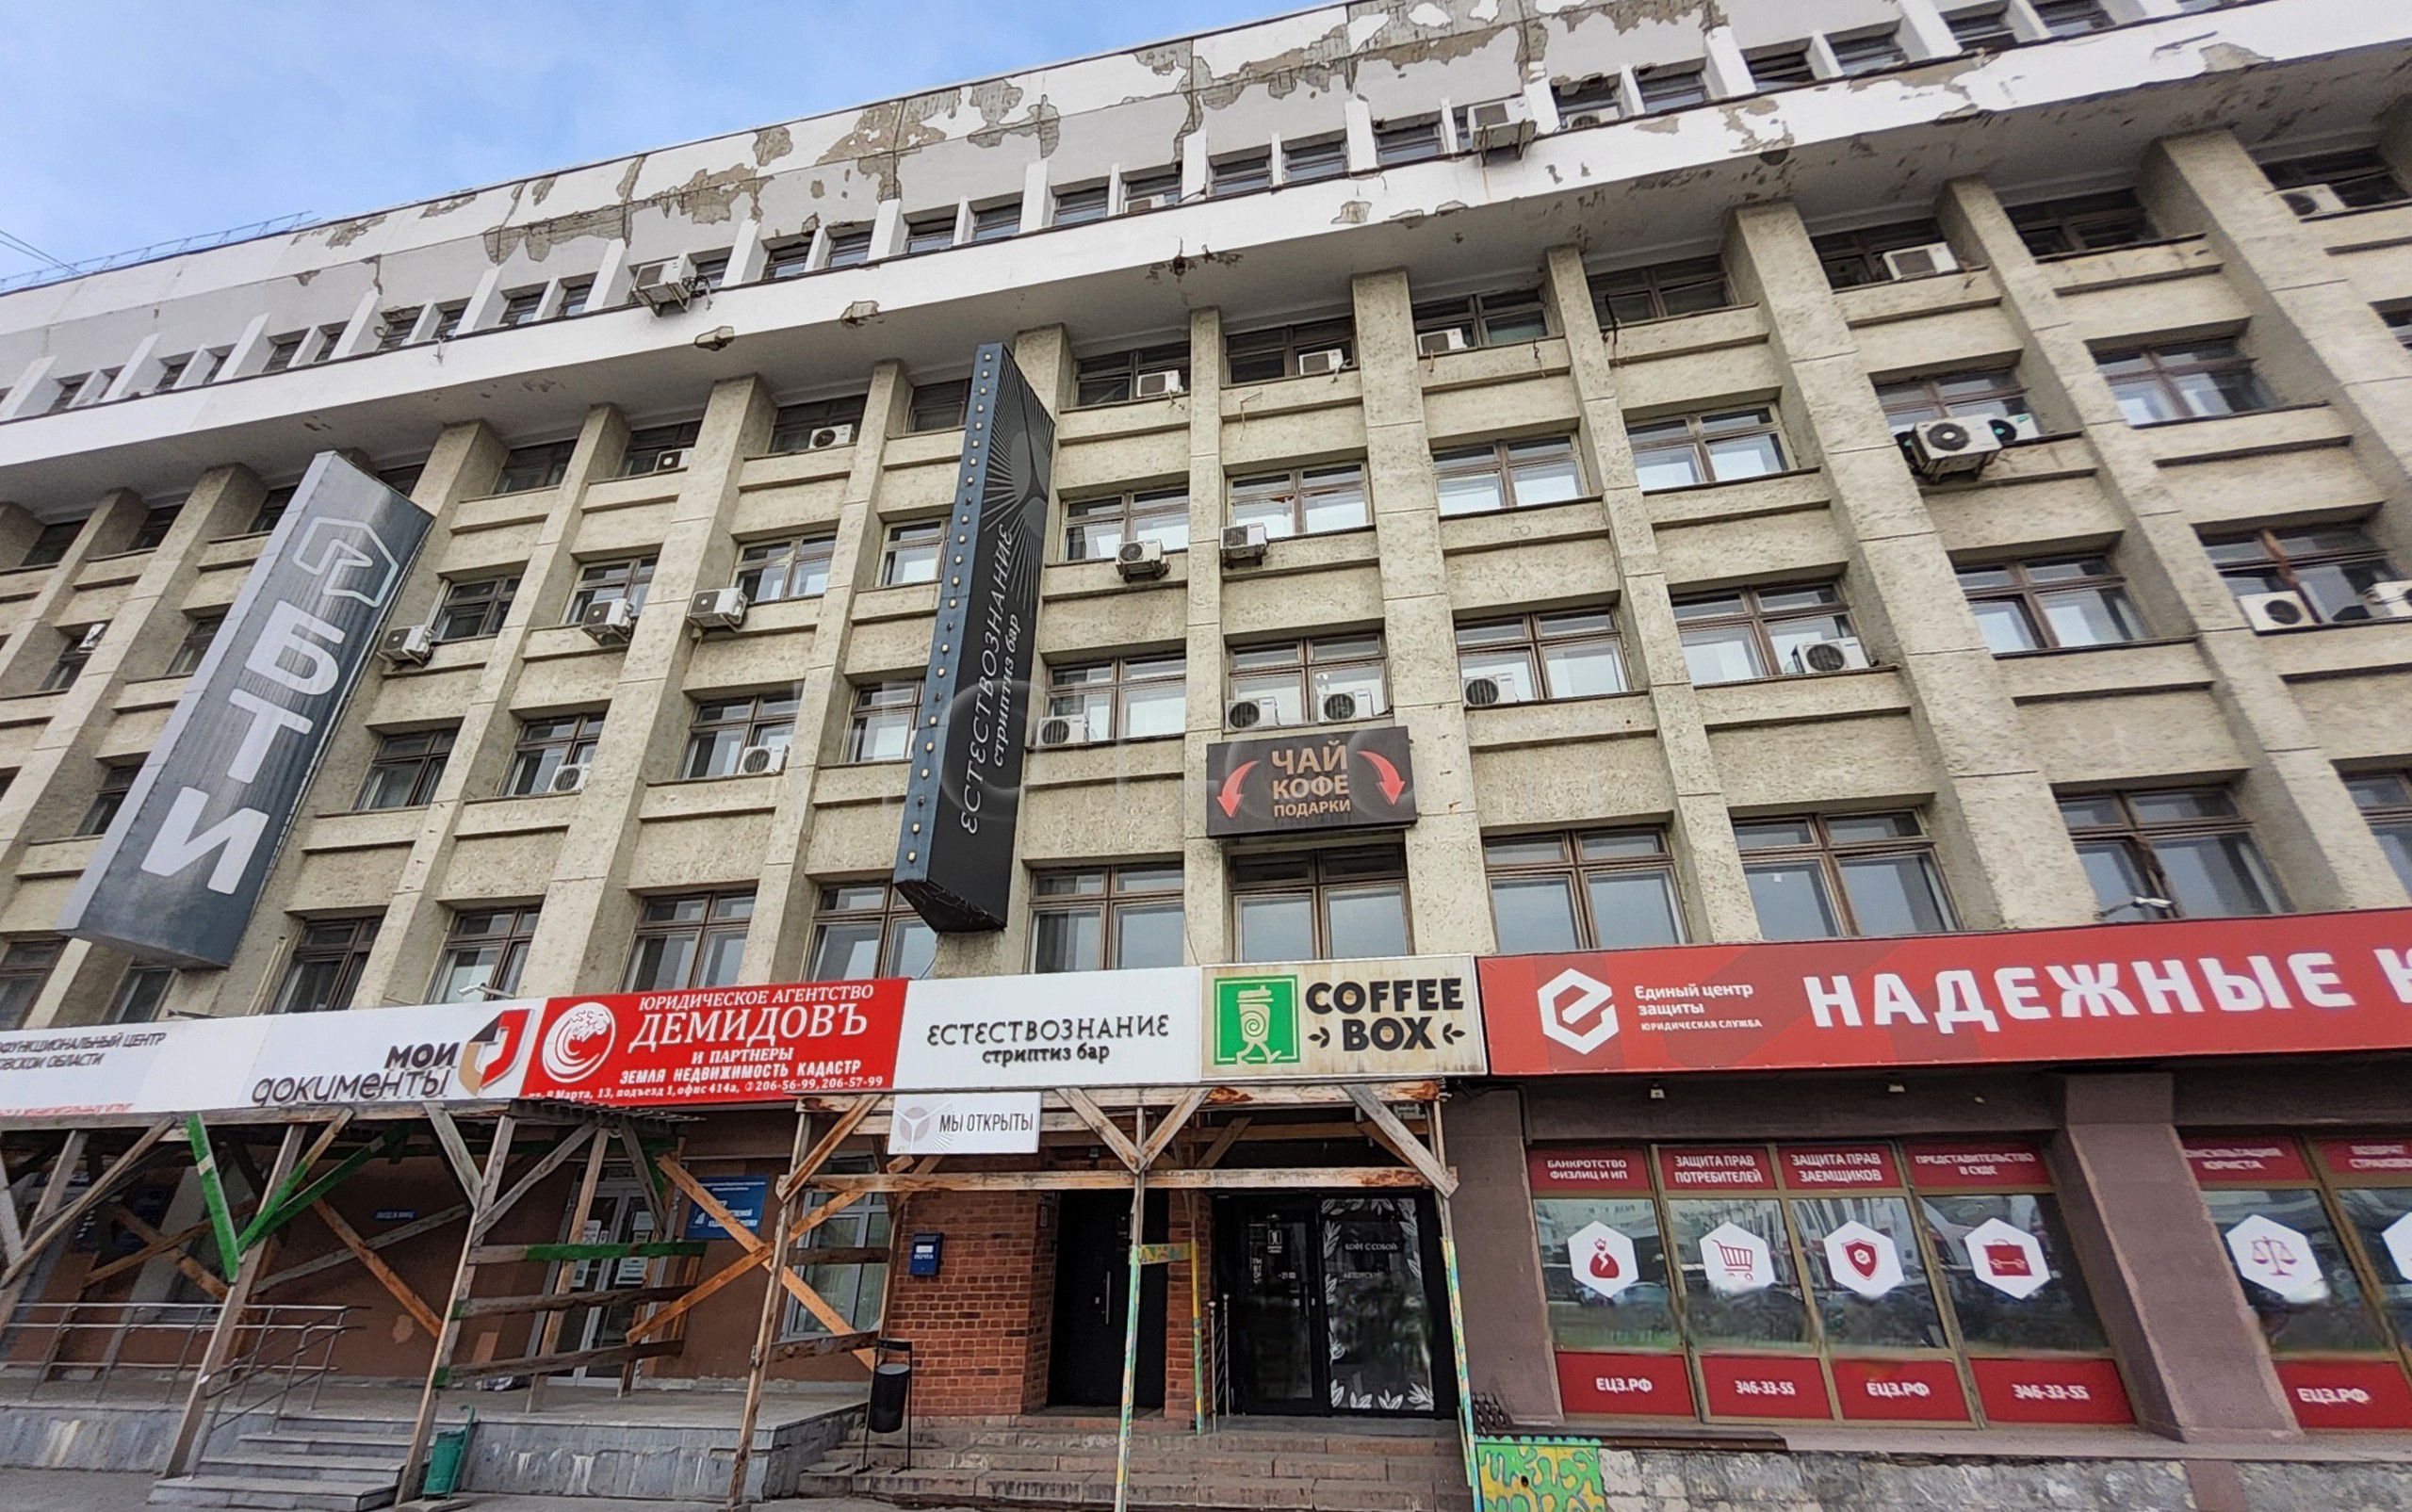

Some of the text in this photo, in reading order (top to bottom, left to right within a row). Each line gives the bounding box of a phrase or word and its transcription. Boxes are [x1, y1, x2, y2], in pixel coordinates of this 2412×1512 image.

[994, 613, 1021, 767] стриптиз бар
[140, 600, 346, 895] БТИ
[1271, 740, 1348, 775] ЧАЙ
[1272, 774, 1350, 801] КОФЕ
[1273, 800, 1351, 819] ПОДАРКИ
[639, 984, 874, 1012] ЮРИДИЧЕСКОЕ АГЕНТСТВО
[1305, 977, 1464, 1015] COFFEE
[1634, 984, 1753, 1000] Единый центр
[1803, 951, 2356, 1034] НАДЕЖНЫЕ
[1638, 1003, 1704, 1016] защиты
[627, 1002, 869, 1053] ДЕМИДОВЪ
[927, 1015, 1170, 1047] ЕСТЕСТВОЗНАНИЕ
[1342, 1017, 1438, 1052] BOX
[1640, 1018, 1763, 1032] ЮРИДИЧЕСКАЯ СЛУЖБА
[122, 1032, 167, 1048] ЦЕНТР
[692, 1047, 794, 1065] И ПАРТНЕРЫ
[982, 1042, 1110, 1068] стриптиз бар
[620, 1060, 861, 1084] ЗЕМЛЯ НЕДВИЖИМОСТЬ КАДАСТР
[597, 1087, 613, 1098] 13,
[616, 1085, 663, 1098] подъезд
[939, 1113, 1034, 1132] МЫ ОТКРЫТЫ
[1546, 1160, 1627, 1169] БАНКРОТСТВО
[1674, 1154, 1755, 1169] ЗАЩИТА ПРАВ
[1790, 1152, 1882, 1167] ЗАЩИТА ПРАВ
[1549, 1170, 1599, 1181] ФИЗЛИЦ
[1610, 1170, 1628, 1179] ИП
[1674, 1169, 1764, 1184] ПОТРЕБИТЕЛЕЙ
[1798, 1169, 1883, 1184] ЗАЕМЩИКОВ
